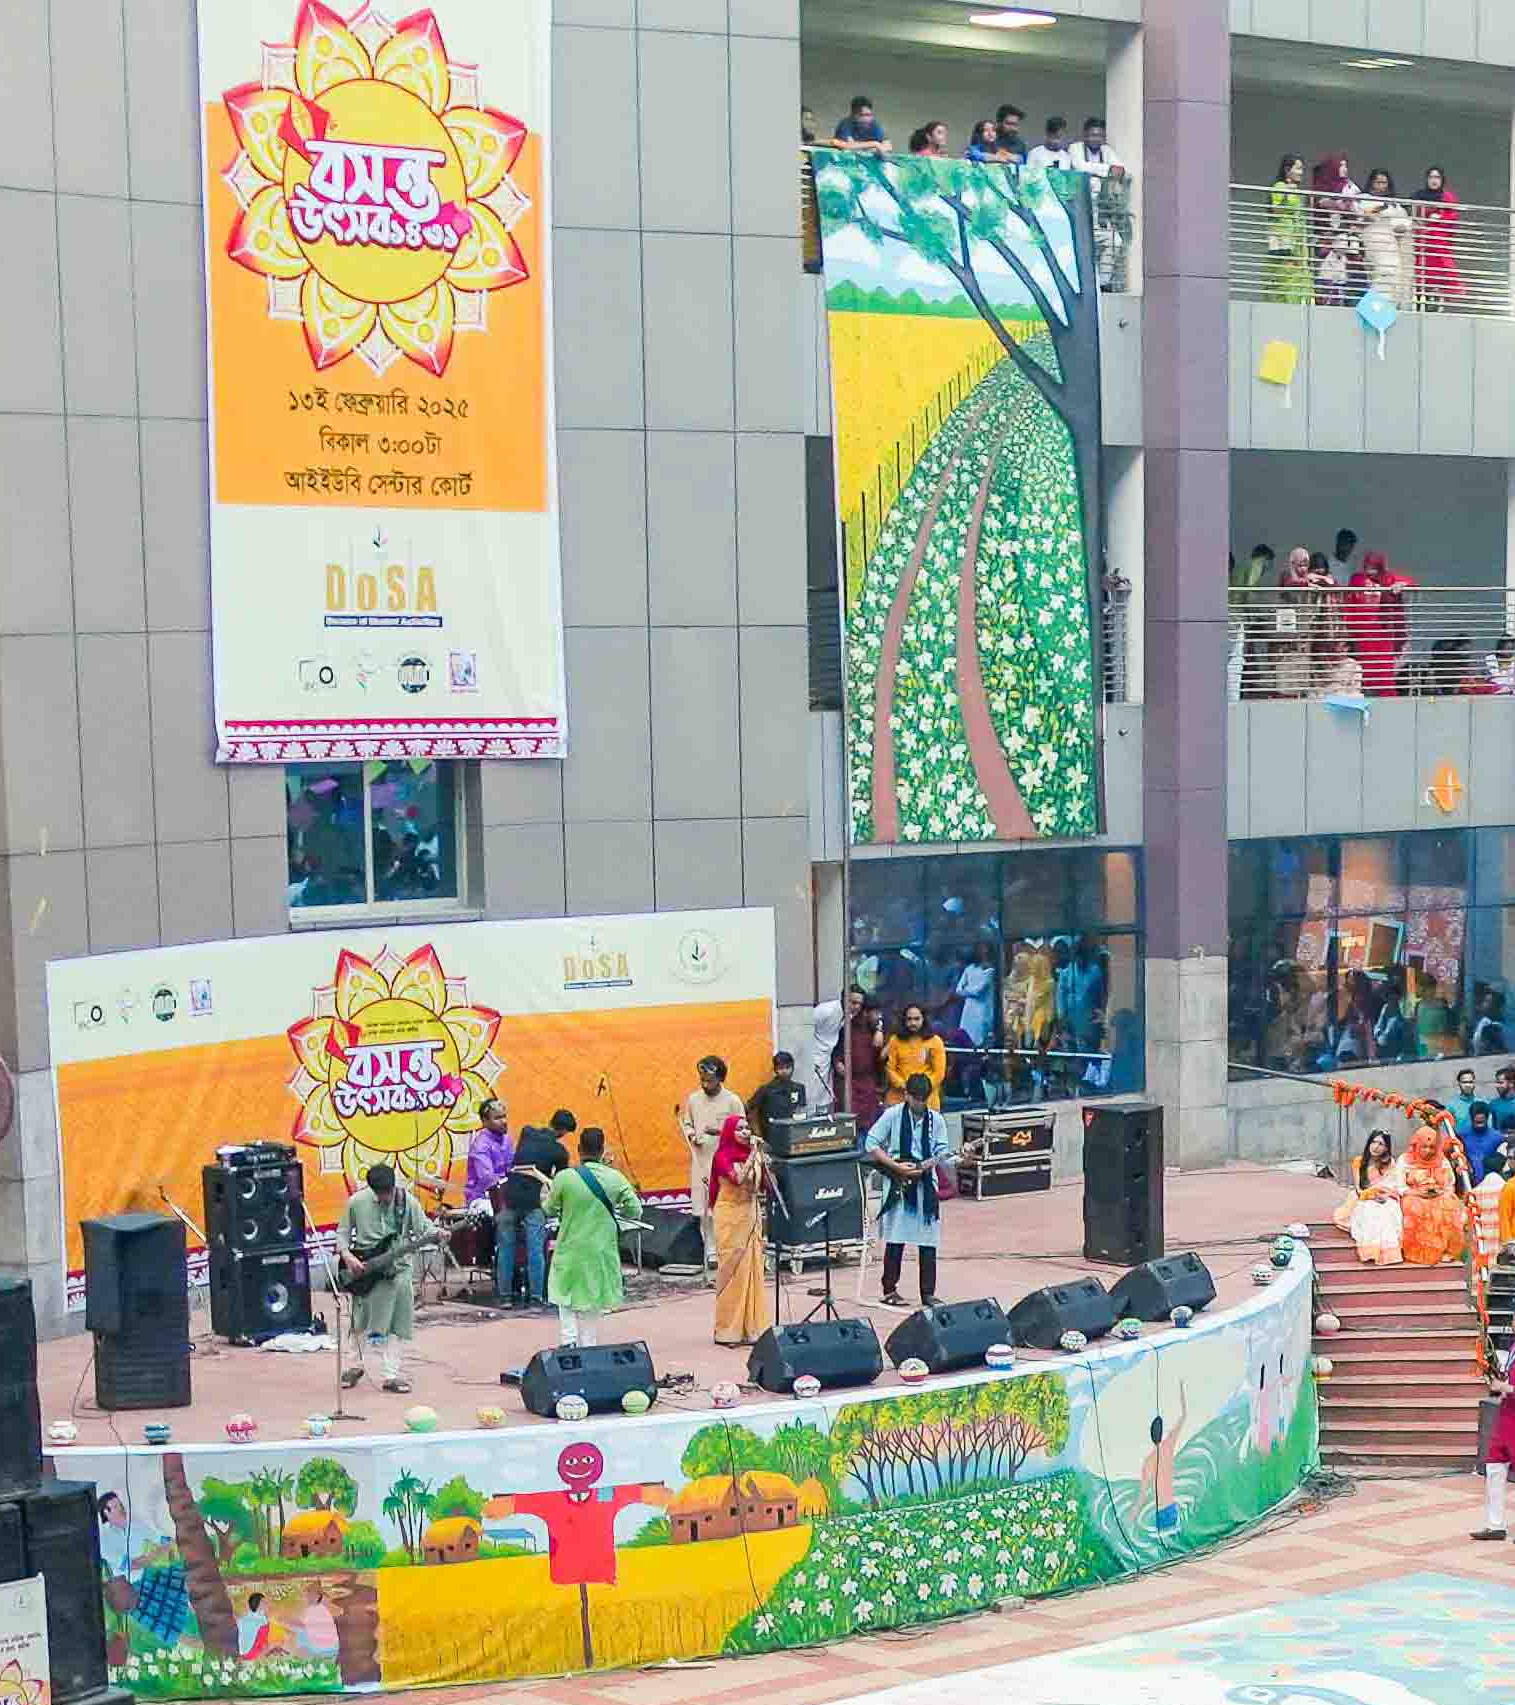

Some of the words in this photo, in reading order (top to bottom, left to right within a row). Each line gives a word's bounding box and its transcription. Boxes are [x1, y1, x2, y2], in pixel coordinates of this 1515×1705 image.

[304, 139, 446, 223] বসন্ত
[417, 395, 469, 419] ২০২৫
[318, 424, 371, 455] বিকাল
[368, 466, 424, 496] সেন্টার
[431, 470, 474, 497] কোর্ট
